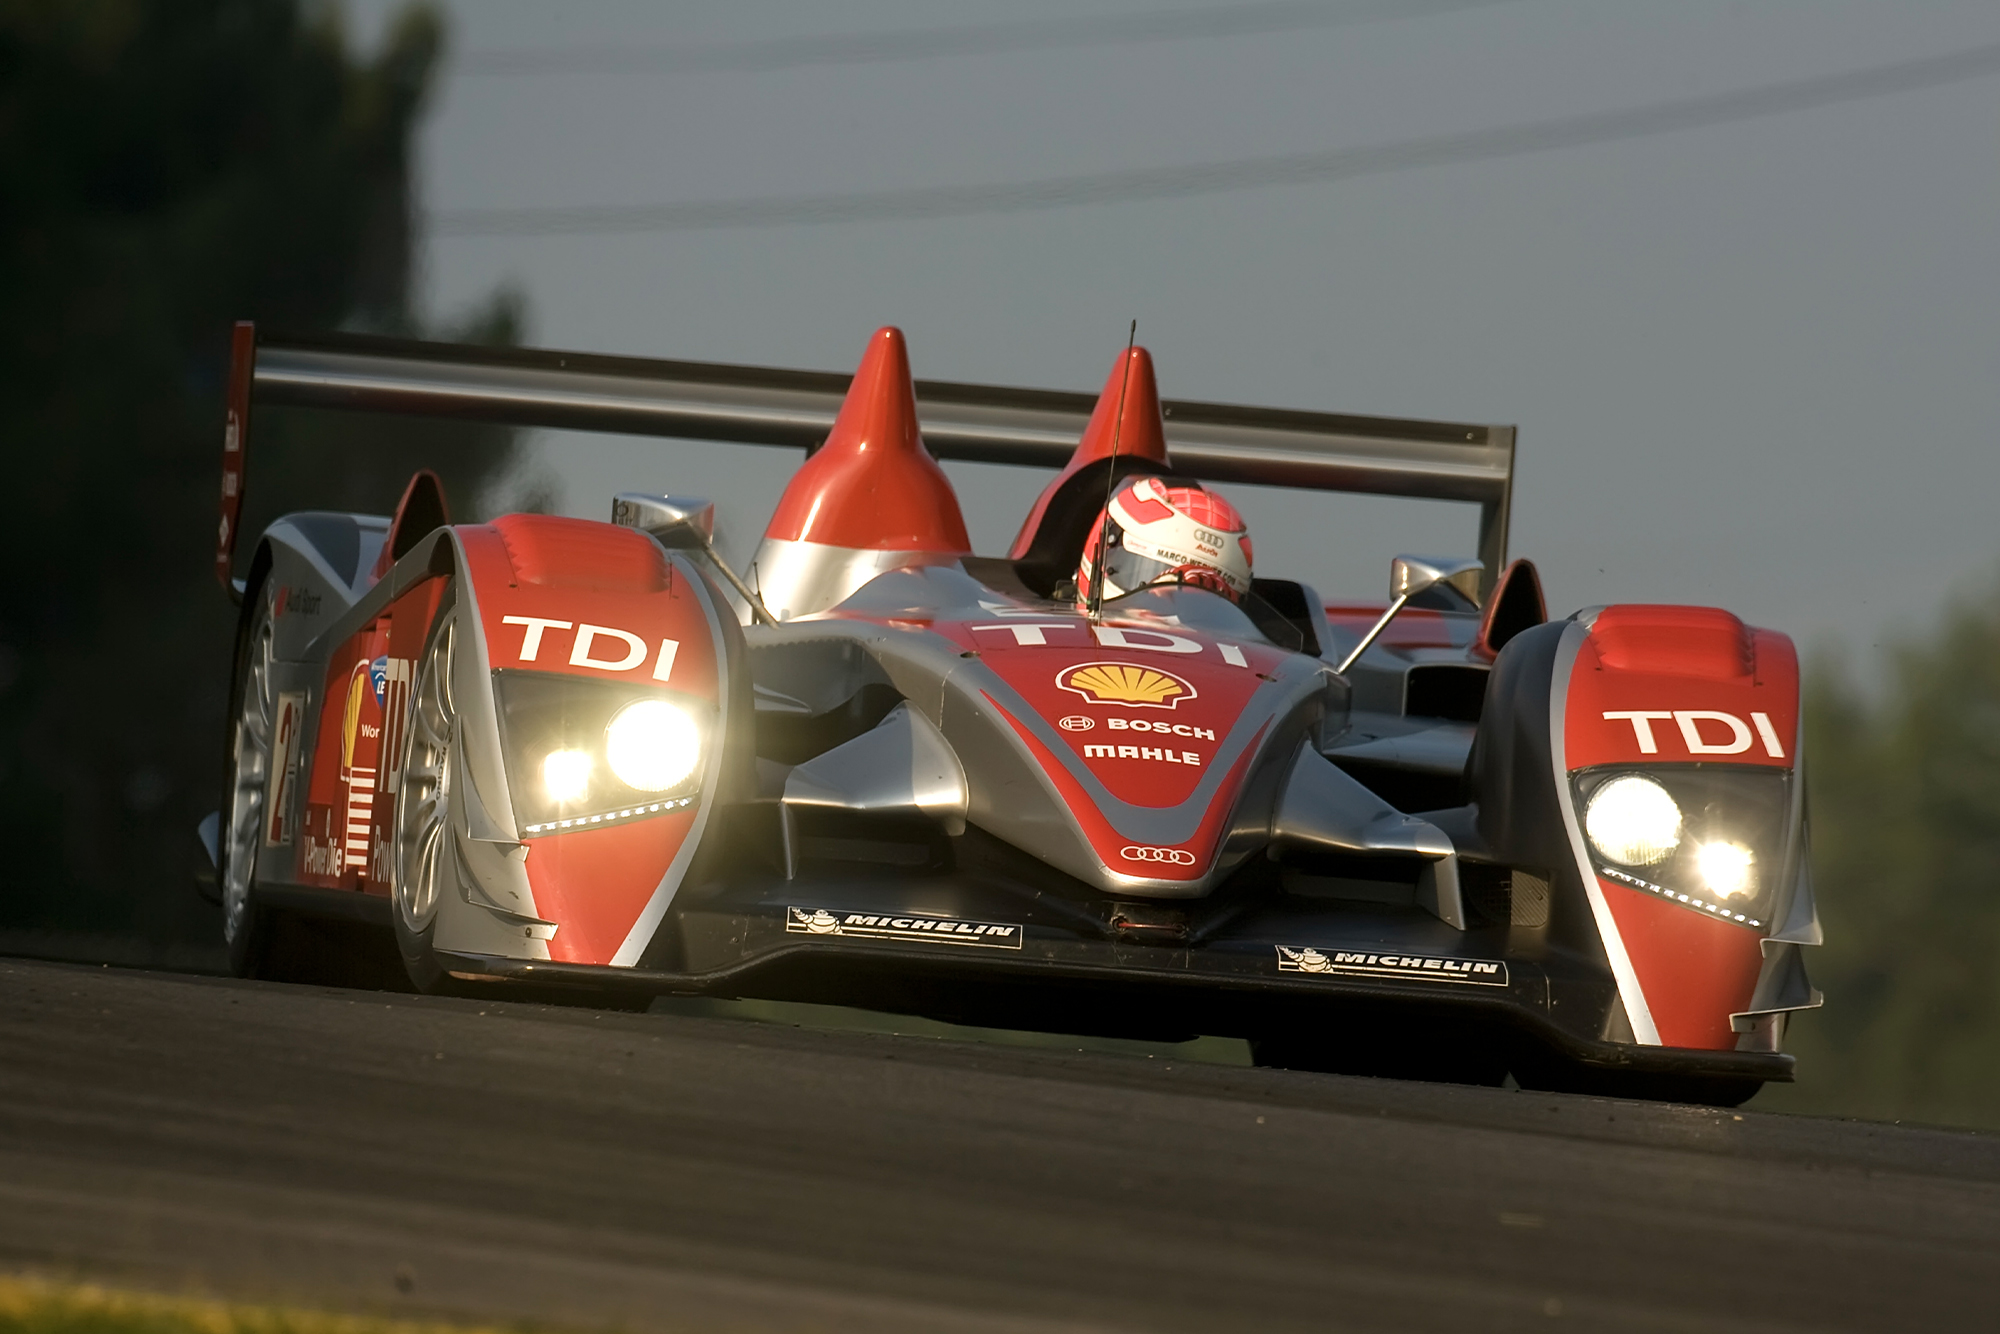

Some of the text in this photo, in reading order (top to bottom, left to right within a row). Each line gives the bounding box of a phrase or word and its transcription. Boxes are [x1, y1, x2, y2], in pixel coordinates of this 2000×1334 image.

[502, 615, 680, 682] TDI
[972, 623, 1248, 668] TDI
[361, 724, 380, 738] Wor
[1107, 718, 1215, 742] BOSCH
[1602, 710, 1785, 758] TDI
[1083, 744, 1201, 766] MAHLE
[326, 837, 343, 878] Die
[371, 824, 392, 883] Pow
[844, 914, 1015, 937] MICHELIN
[1334, 952, 1499, 974] MICHELIN
